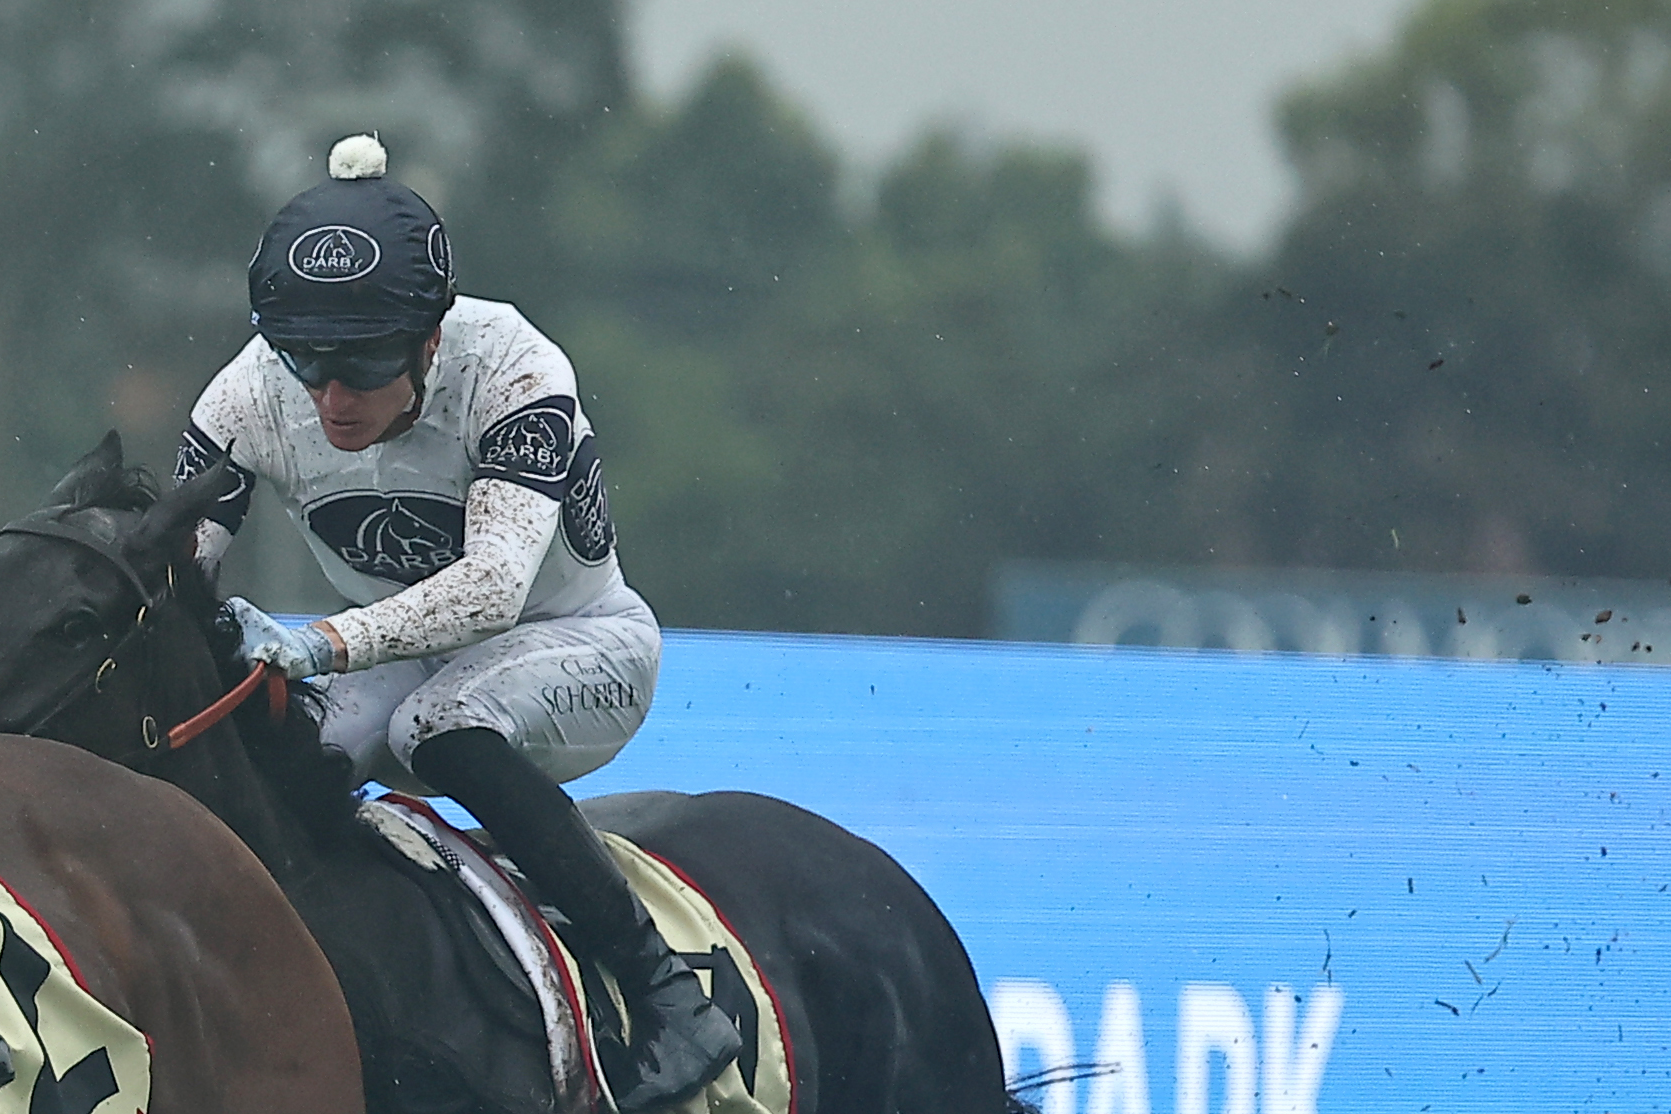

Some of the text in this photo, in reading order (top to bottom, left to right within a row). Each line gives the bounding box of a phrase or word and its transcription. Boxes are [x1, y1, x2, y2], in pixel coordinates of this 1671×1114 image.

[302, 256, 364, 270] DARBY
[486, 444, 562, 470] DARBY
[570, 478, 606, 550] DARBY
[341, 546, 459, 570] DARB
